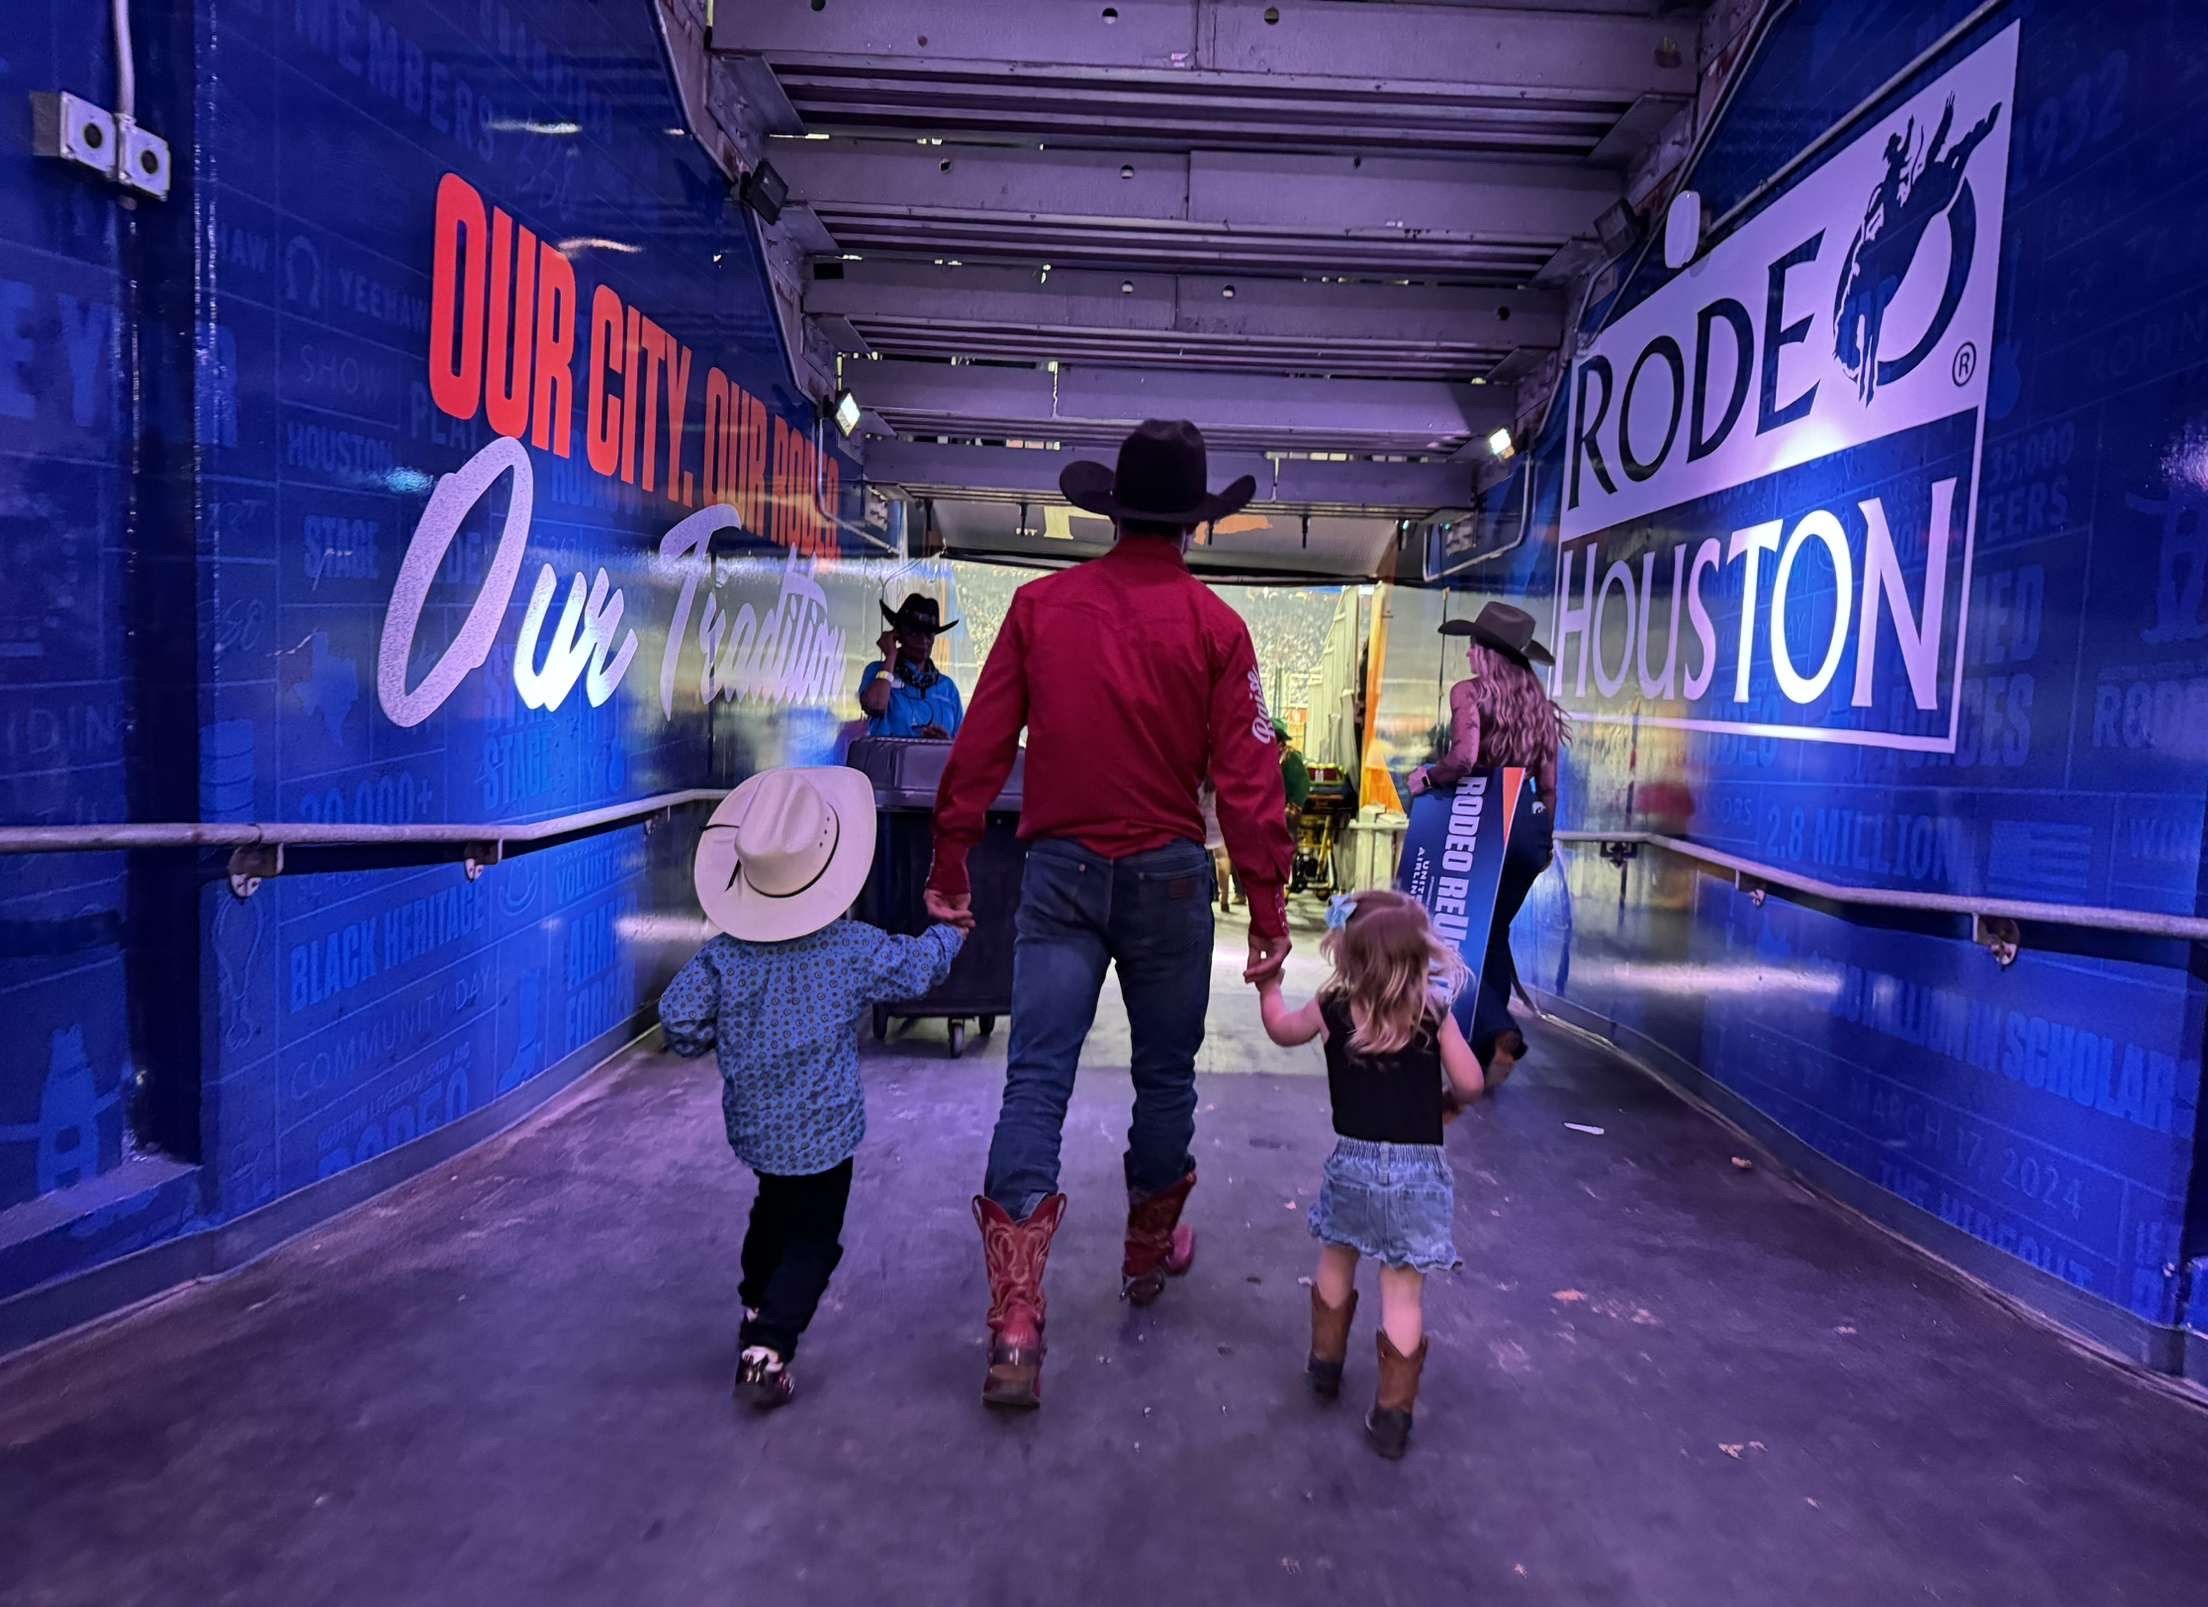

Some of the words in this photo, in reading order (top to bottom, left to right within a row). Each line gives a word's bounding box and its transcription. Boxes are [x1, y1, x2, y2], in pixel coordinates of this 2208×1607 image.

[428, 171, 577, 460] OUR
[586, 283, 694, 508] CITY.
[703, 366, 769, 537] OUR
[1567, 165, 1978, 512] RODEO
[376, 435, 640, 729] Our
[659, 502, 848, 722] Tradition
[1551, 476, 1959, 711] HOUSTON
[1410, 845, 1425, 897] AIRLIN
[1441, 776, 1488, 874] RODEO
[1765, 804, 1807, 864] 2.8
[1416, 859, 1431, 904] UNITE
[289, 916, 378, 1016] BLACK
[382, 880, 485, 971] HERITAGE
[454, 965, 494, 1010] DAY
[2000, 1147, 2081, 1223] 2024
